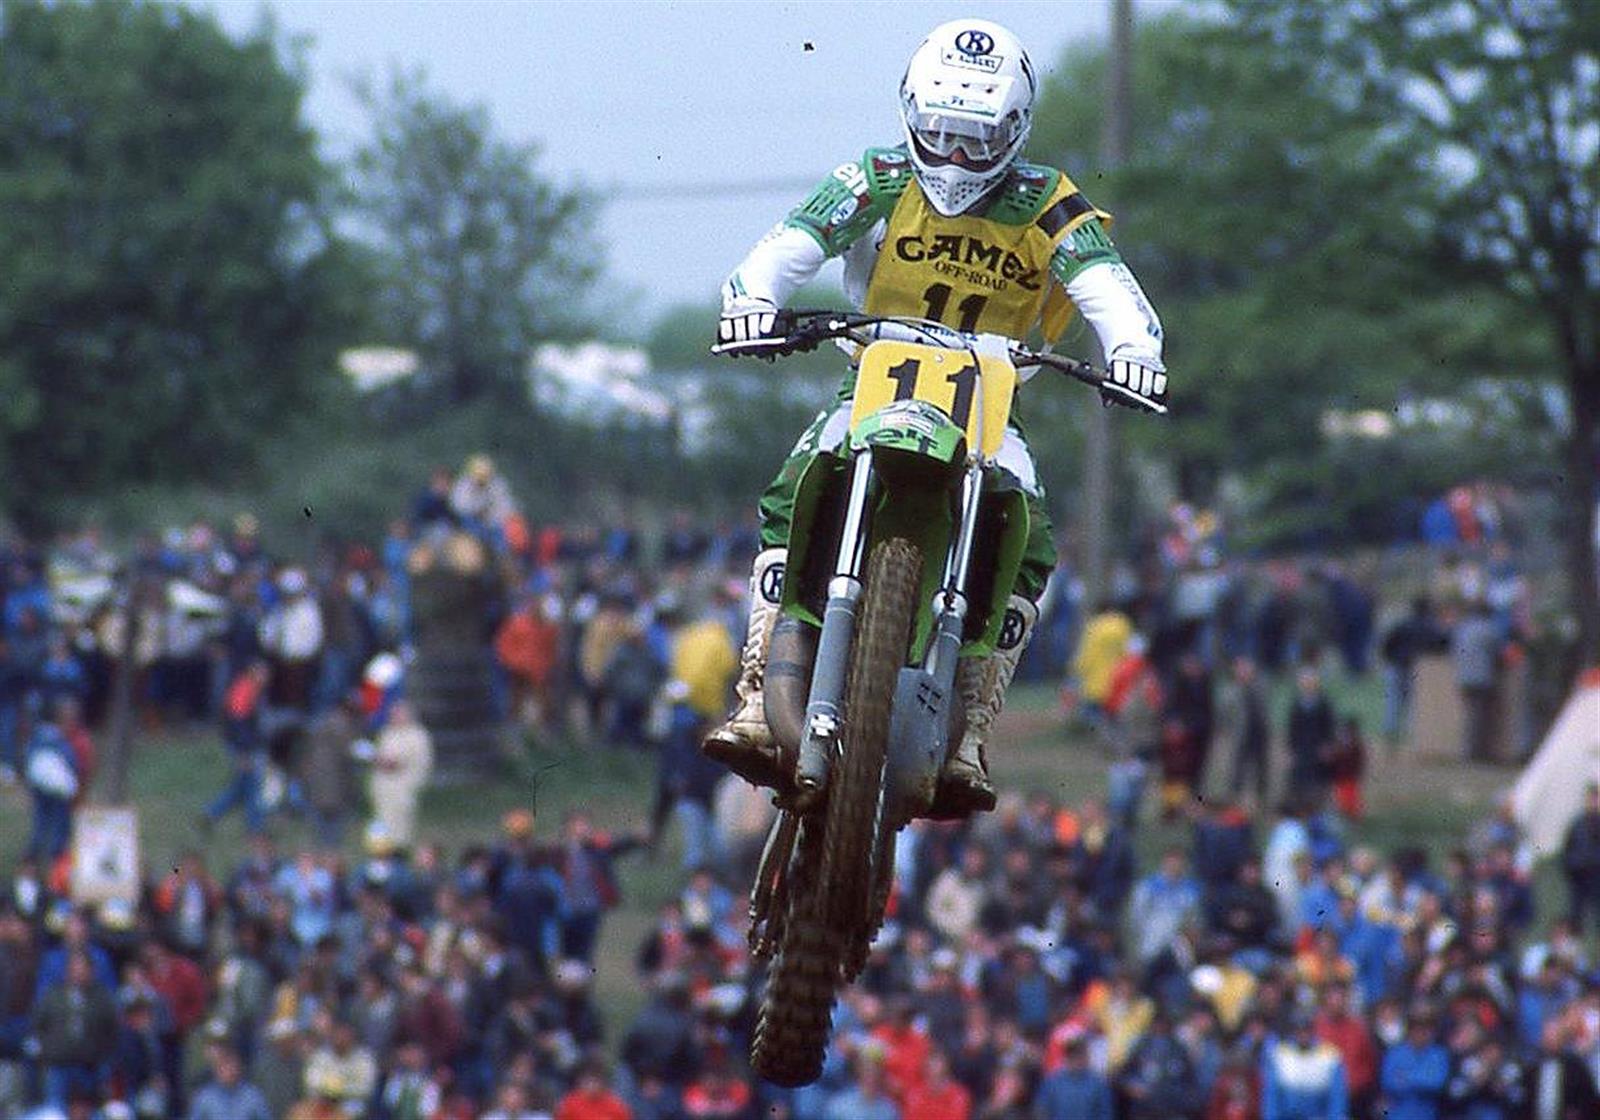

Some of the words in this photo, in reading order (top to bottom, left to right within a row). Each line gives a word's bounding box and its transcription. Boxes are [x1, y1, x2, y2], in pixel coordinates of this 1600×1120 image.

[896, 234, 1041, 291] CAMEL
[935, 261, 1008, 291] OFF-ROAD
[923, 282, 988, 332] 11
[887, 358, 979, 431] 11
